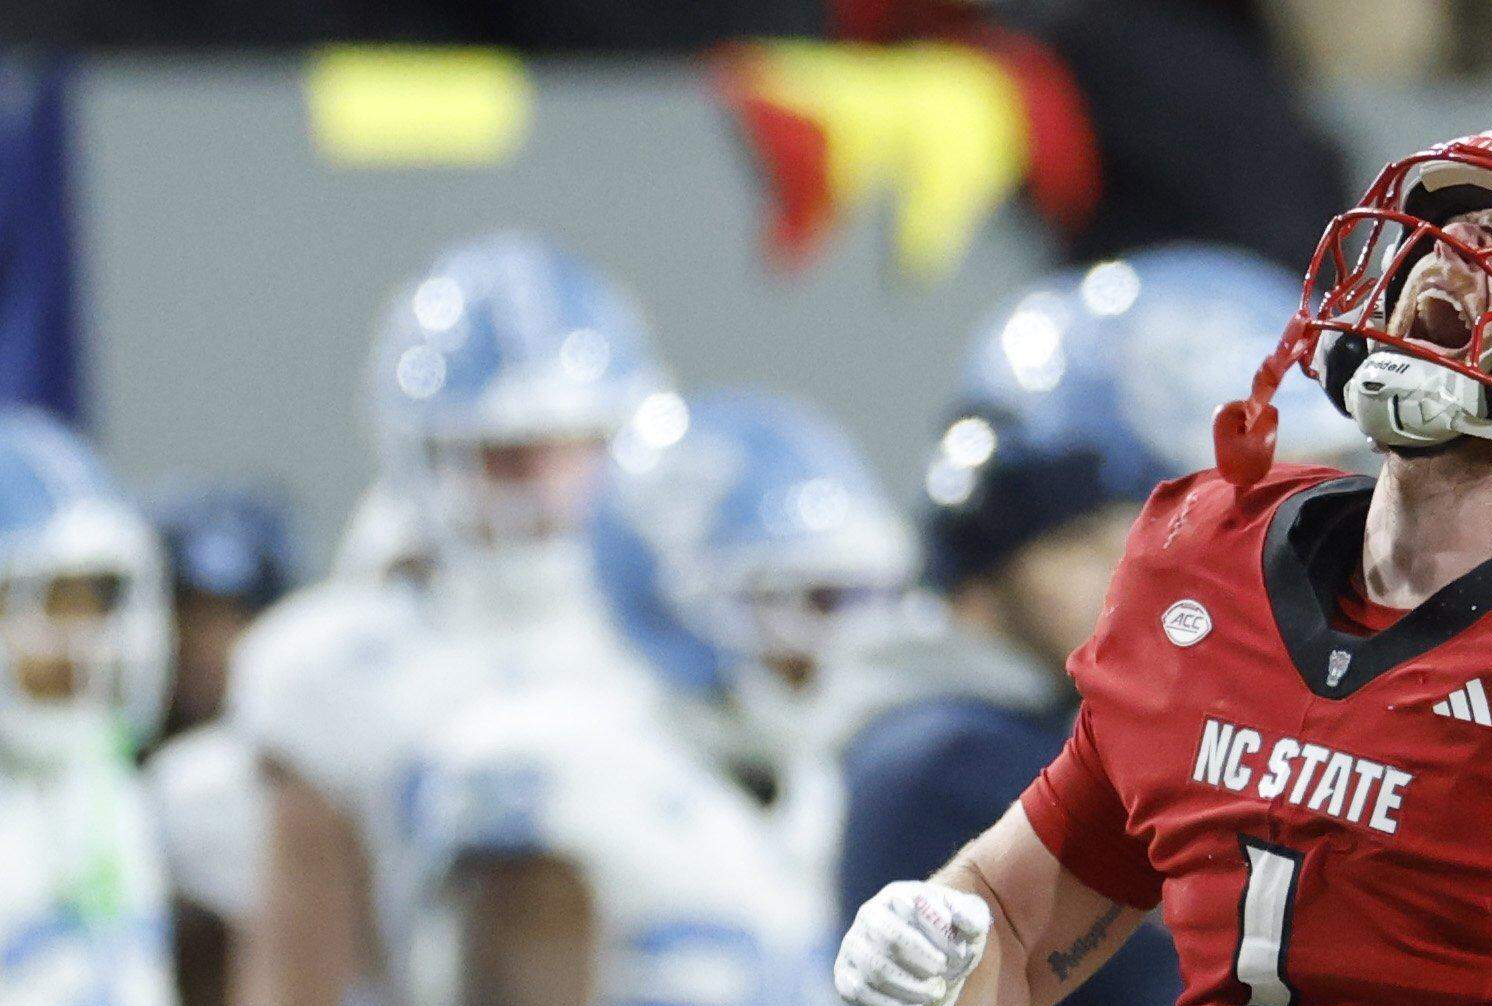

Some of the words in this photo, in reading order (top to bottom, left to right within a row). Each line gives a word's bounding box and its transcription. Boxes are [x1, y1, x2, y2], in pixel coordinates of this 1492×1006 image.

[1171, 612, 1204, 630] ACC
[1192, 718, 1263, 792] NC
[1257, 737, 1414, 835] STATE
